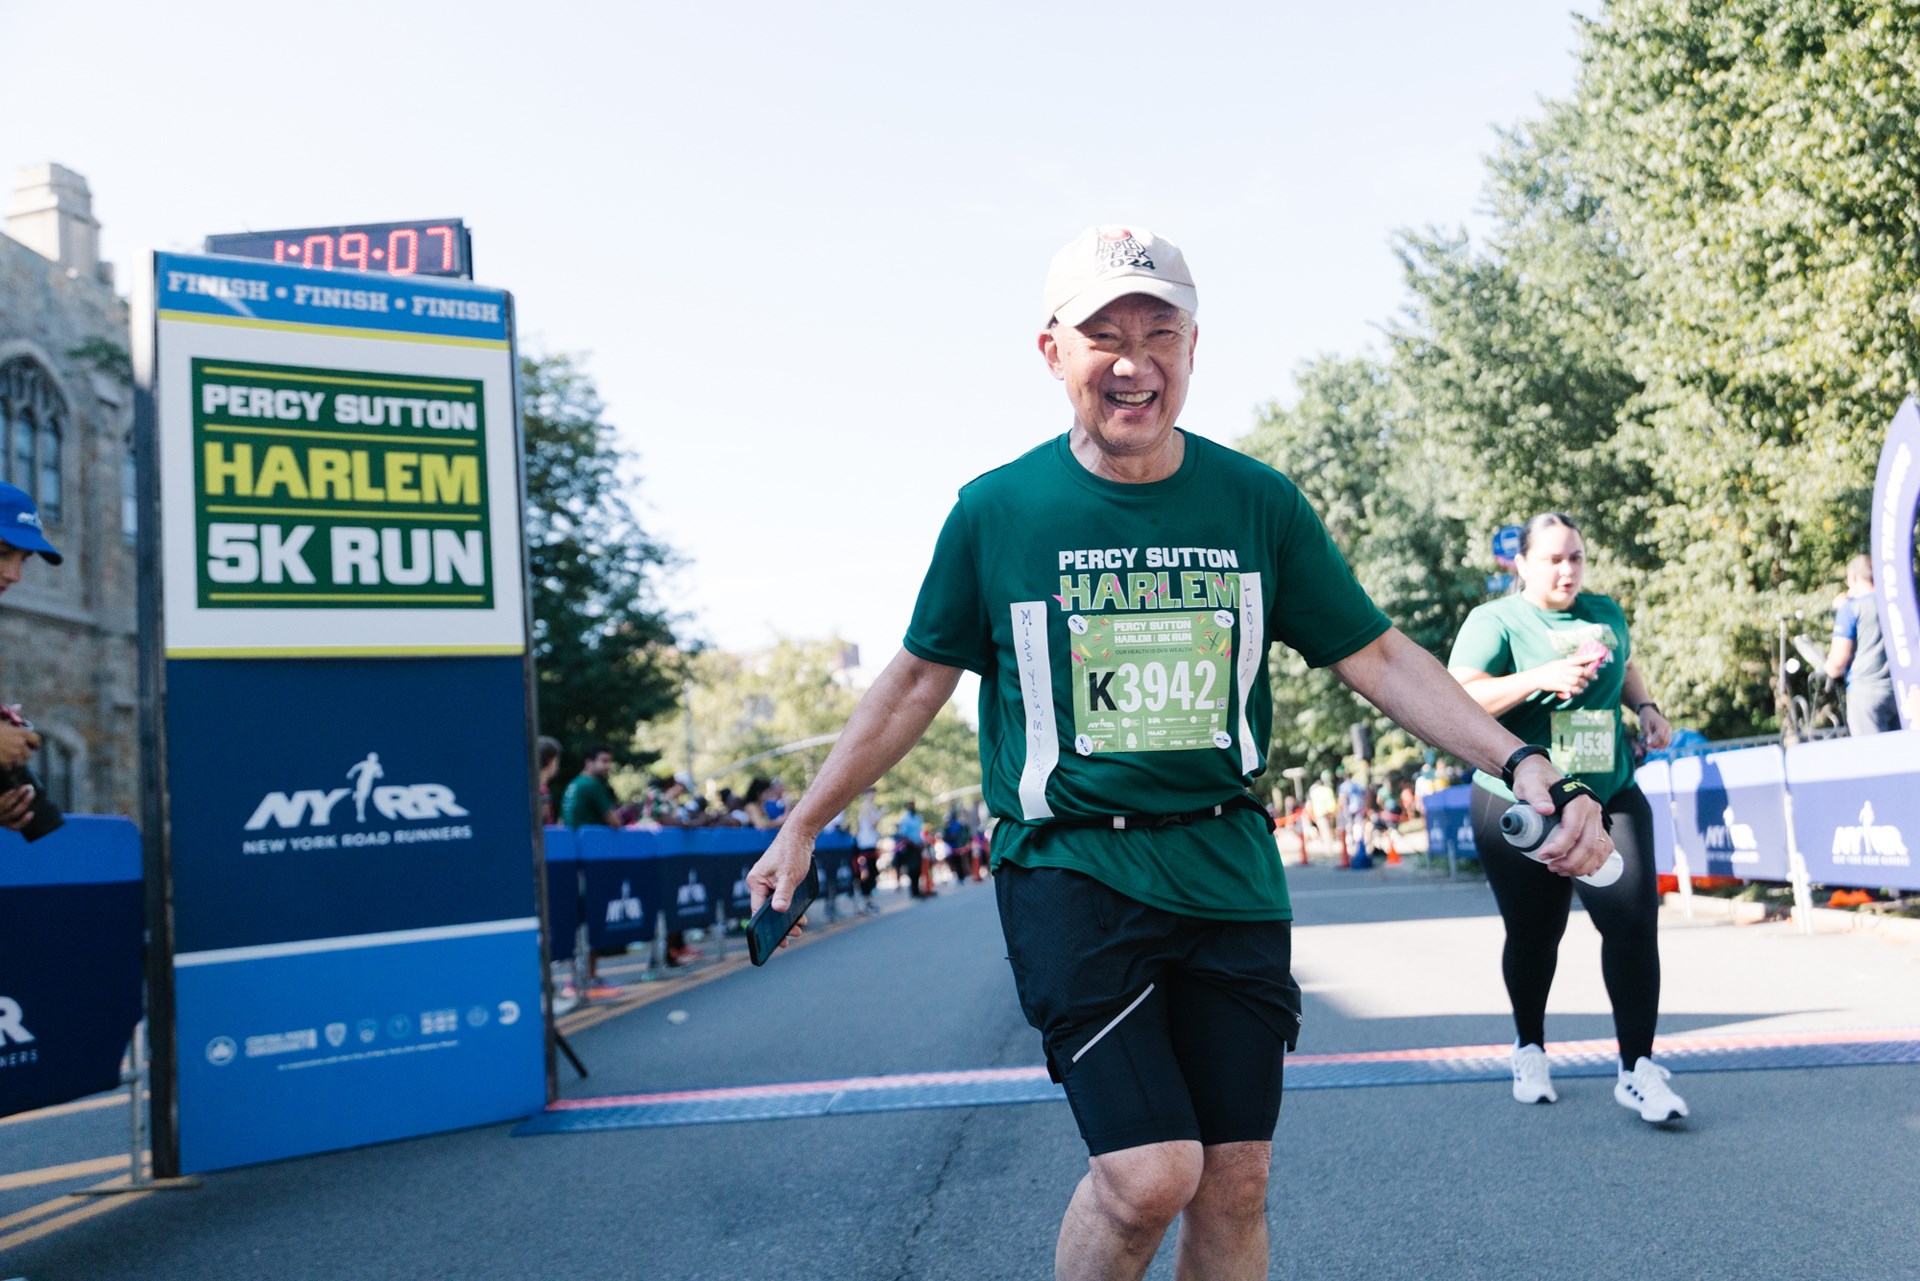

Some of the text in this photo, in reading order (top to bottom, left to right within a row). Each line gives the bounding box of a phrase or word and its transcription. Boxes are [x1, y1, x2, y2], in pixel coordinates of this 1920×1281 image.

[168, 271, 499, 323] FINISH FINISH FINISH
[202, 384, 477, 430] PERCY SUTTON
[204, 441, 480, 505] HARLEM
[207, 522, 485, 586] 5K RUN
[1058, 547, 1239, 571] PERCY SUTTON
[1060, 571, 1240, 611] HARLEM
[1114, 620, 1192, 632] PERCY SUTTON
[1114, 633, 1152, 644] HARLEM
[243, 825, 473, 855] NEW YORK ROAD RUNNERS
